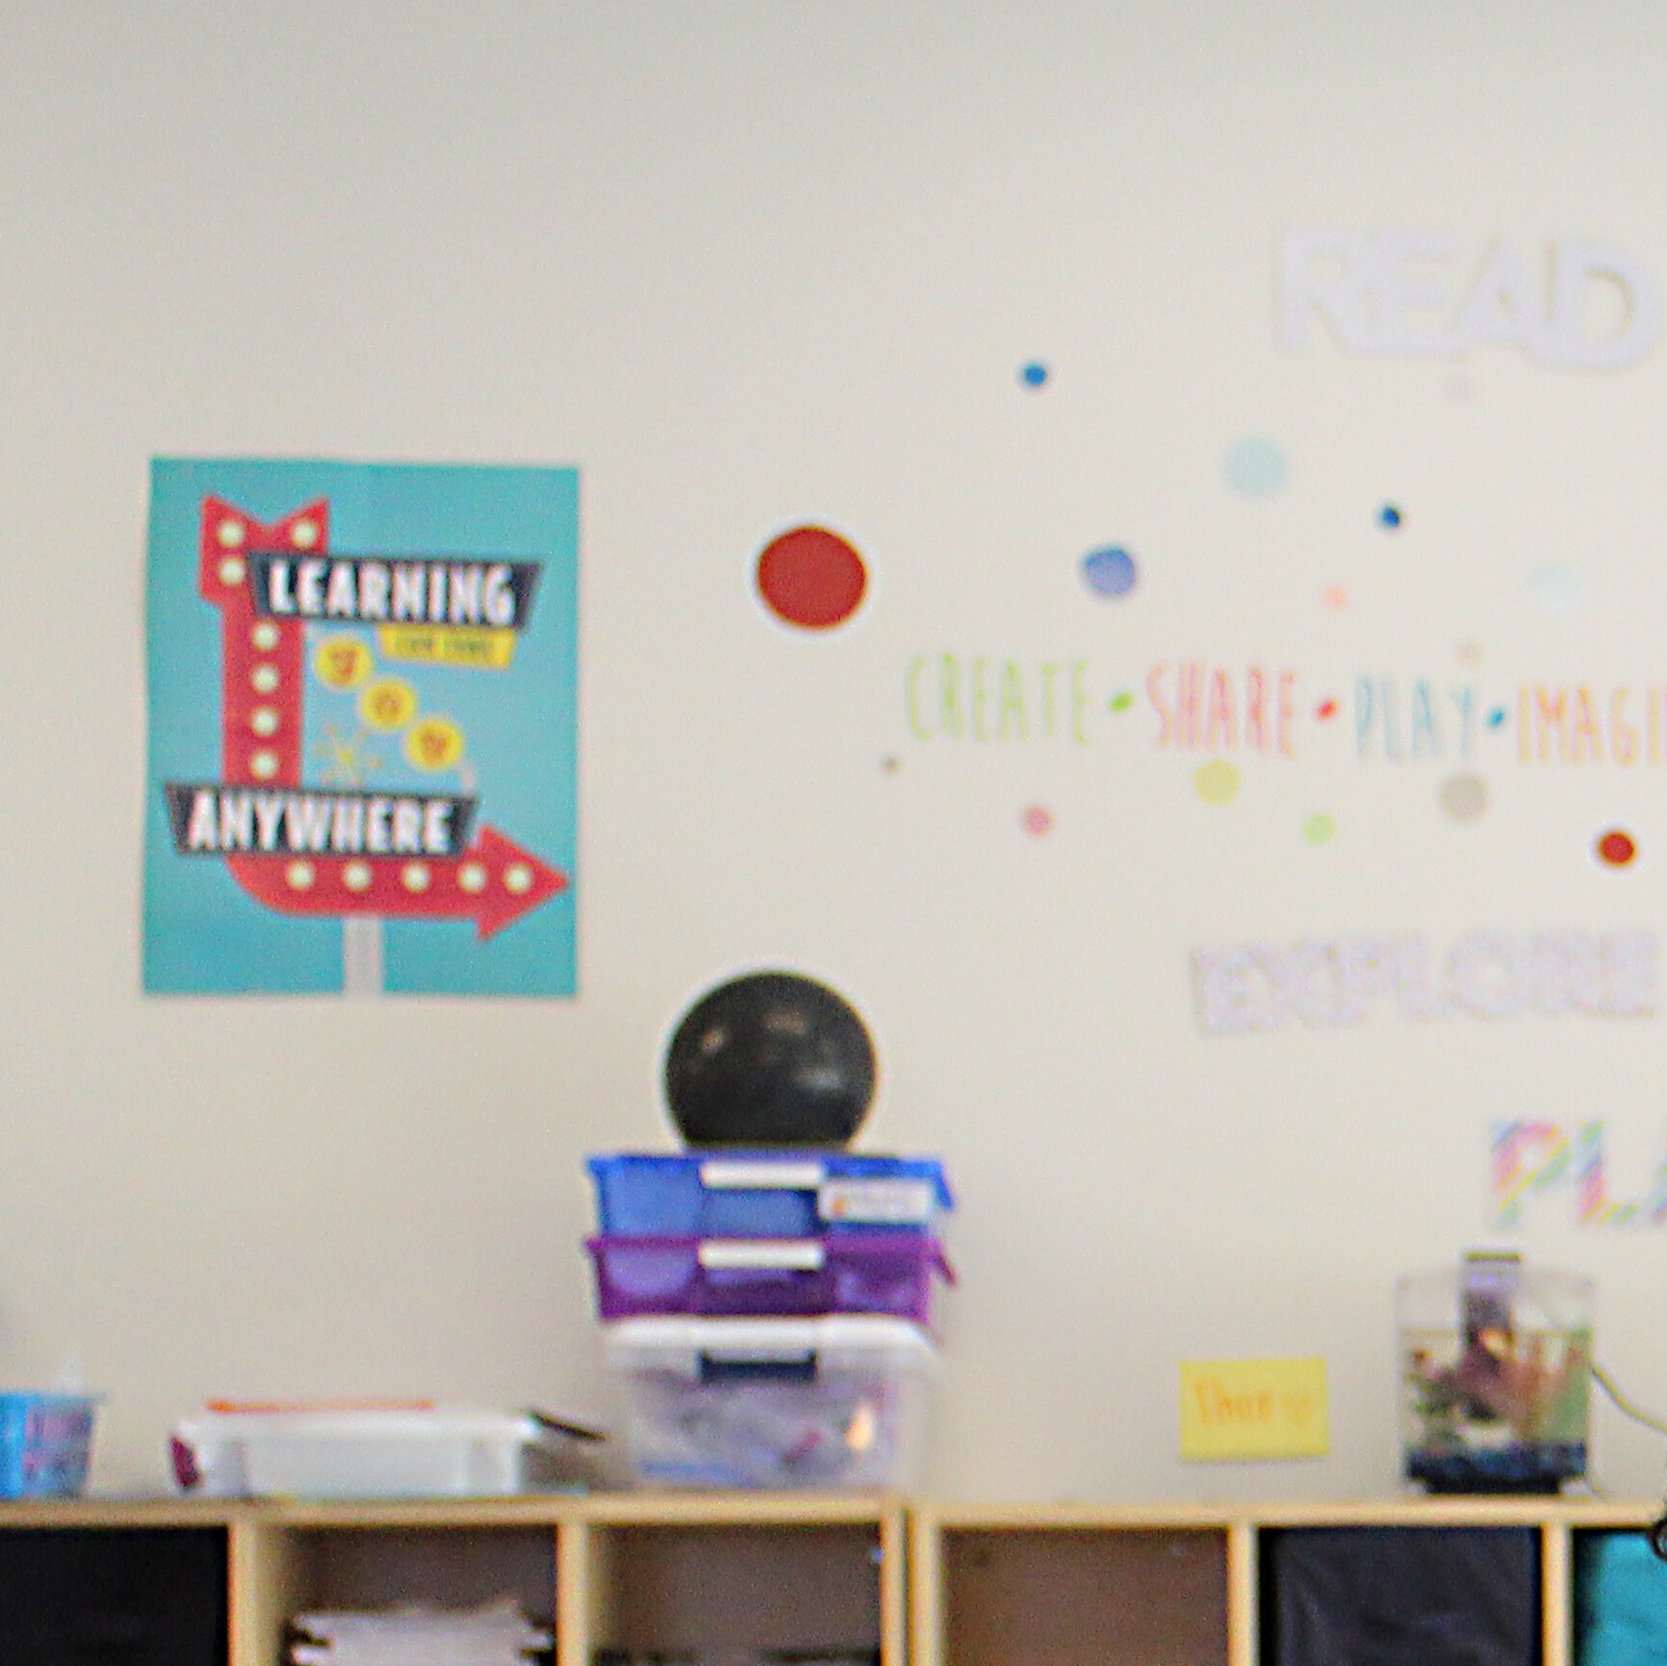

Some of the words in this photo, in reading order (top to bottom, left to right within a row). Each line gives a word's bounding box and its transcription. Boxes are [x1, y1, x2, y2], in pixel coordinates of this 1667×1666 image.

[1274, 222, 1666, 372] READ
[268, 557, 516, 624] LEARNING
[905, 652, 1090, 745] CREATE
[1147, 660, 1297, 757] SHARE
[1356, 672, 1474, 764] PLAY
[187, 789, 452, 853] ANYWHERE
[1192, 932, 1658, 1034] EXPLORE
